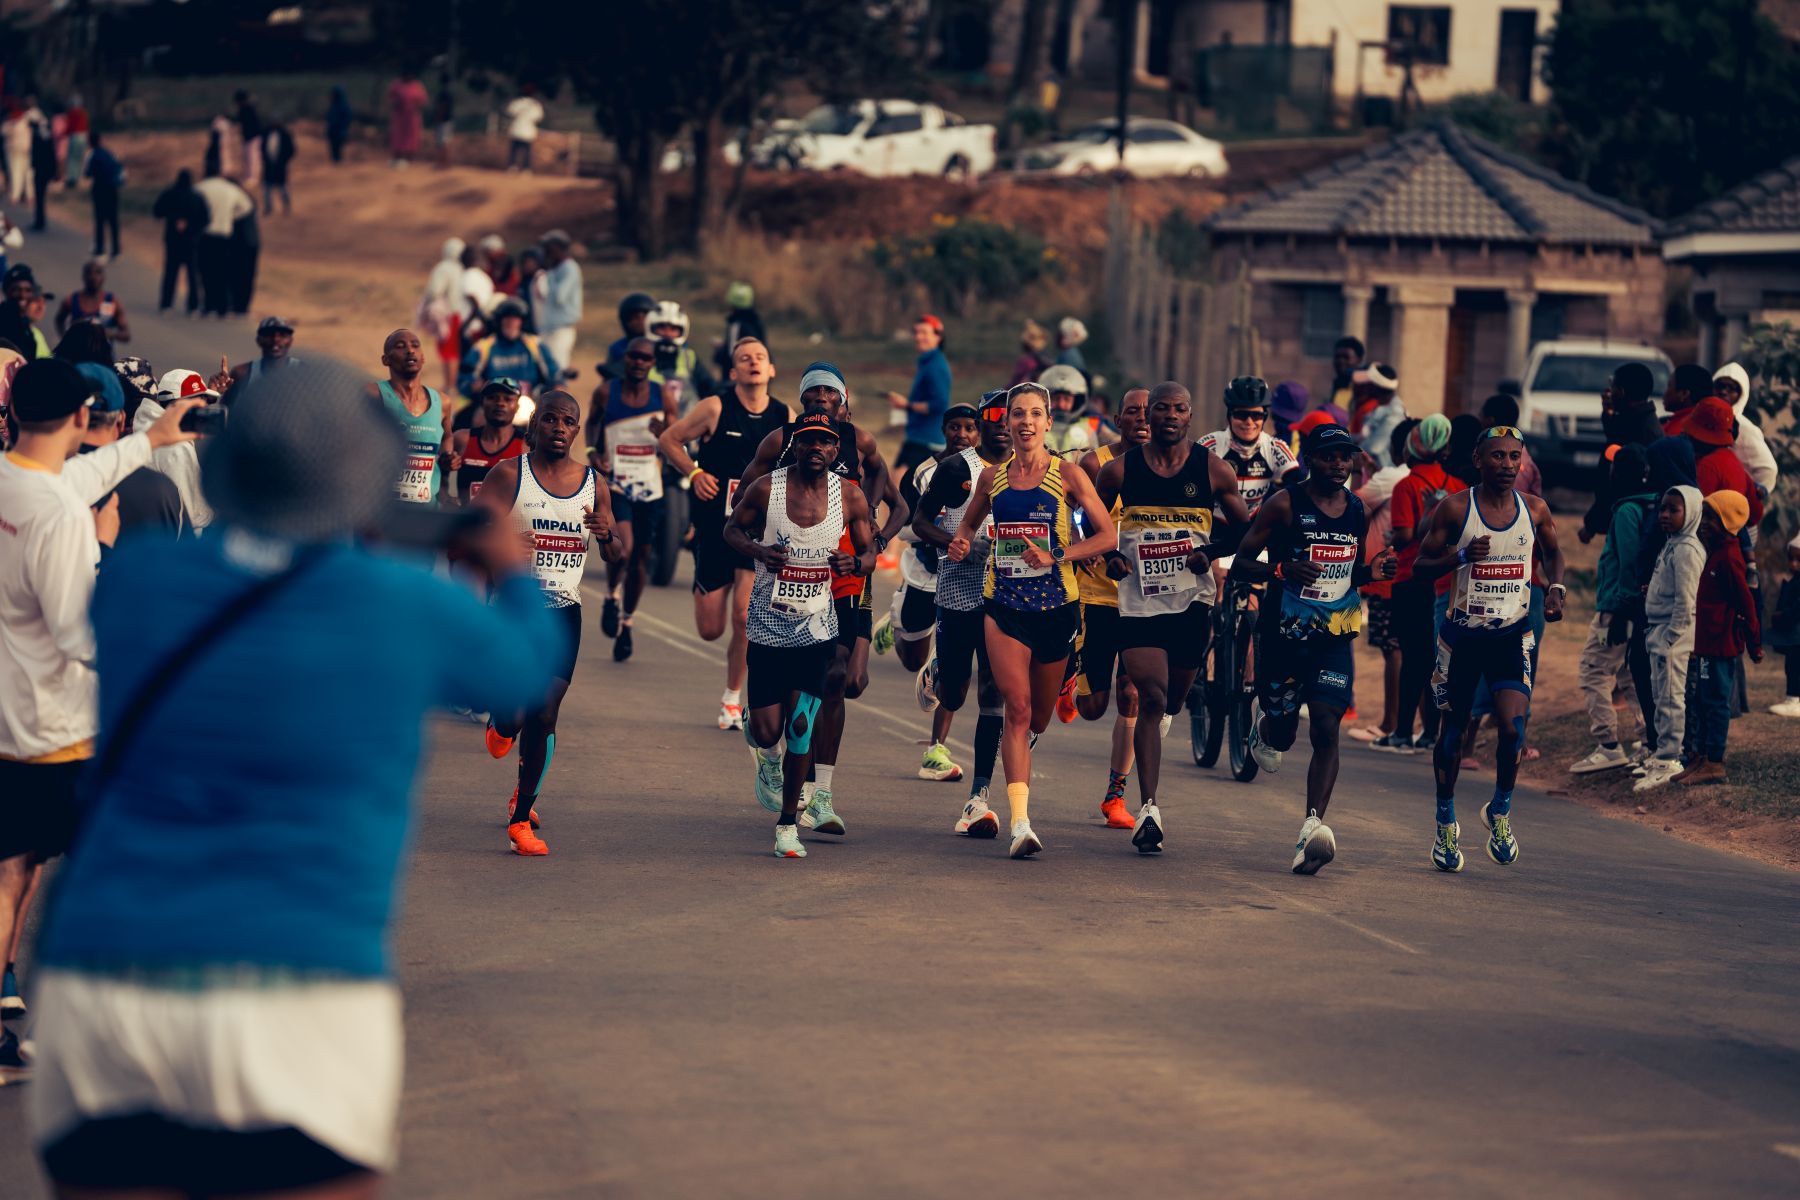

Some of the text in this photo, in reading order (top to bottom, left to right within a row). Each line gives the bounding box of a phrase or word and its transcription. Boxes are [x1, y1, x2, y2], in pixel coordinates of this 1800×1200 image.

[532, 519, 582, 533] IMPALA
[1000, 527, 1044, 535] THIRSTI
[1142, 543, 1190, 555] THIRSTI
[536, 552, 582, 568] B57450
[782, 569, 828, 579] THIRSTI
[1474, 567, 1521, 575] THIRSTI
[778, 582, 824, 599] B55382
[1474, 582, 1520, 593] Sandile
